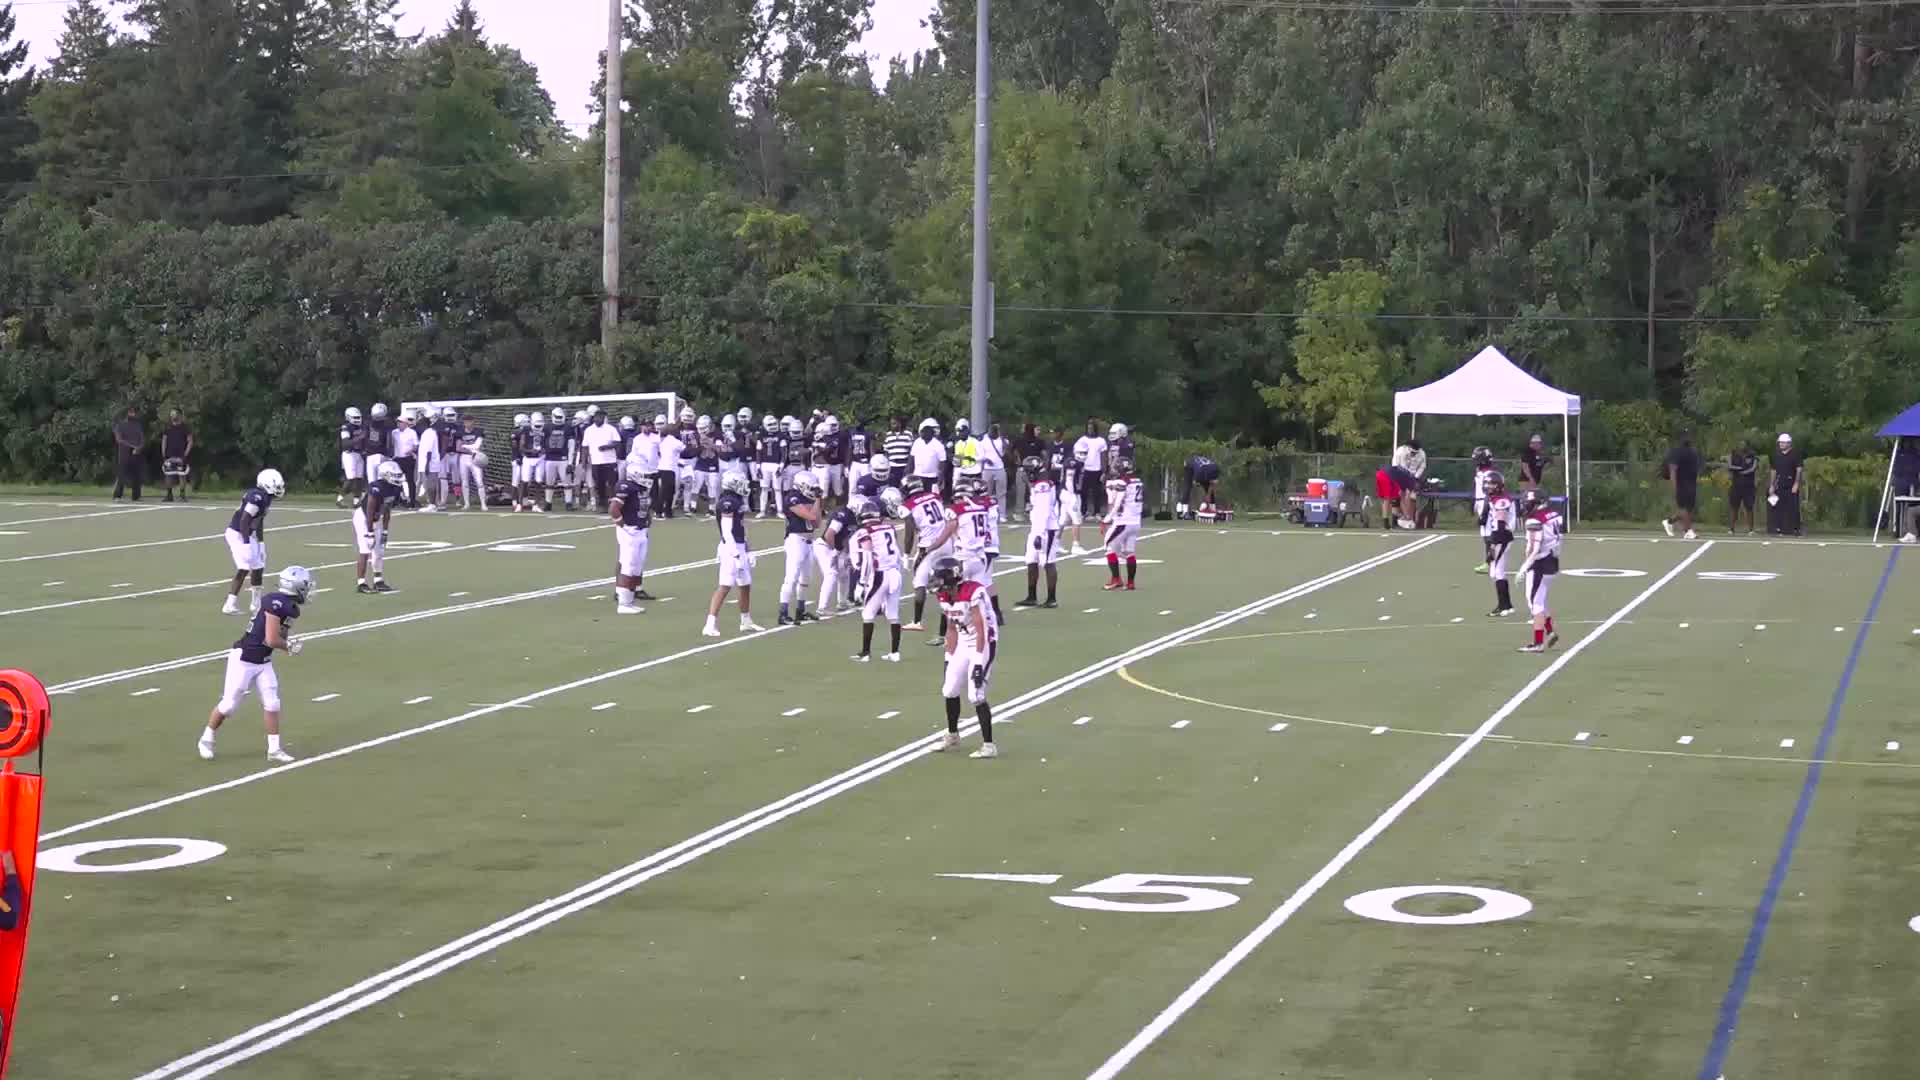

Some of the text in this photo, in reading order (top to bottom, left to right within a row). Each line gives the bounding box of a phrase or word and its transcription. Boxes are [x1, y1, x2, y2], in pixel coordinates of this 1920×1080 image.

[922, 500, 944, 525] 50
[971, 513, 985, 538] 19
[884, 531, 895, 555] 2
